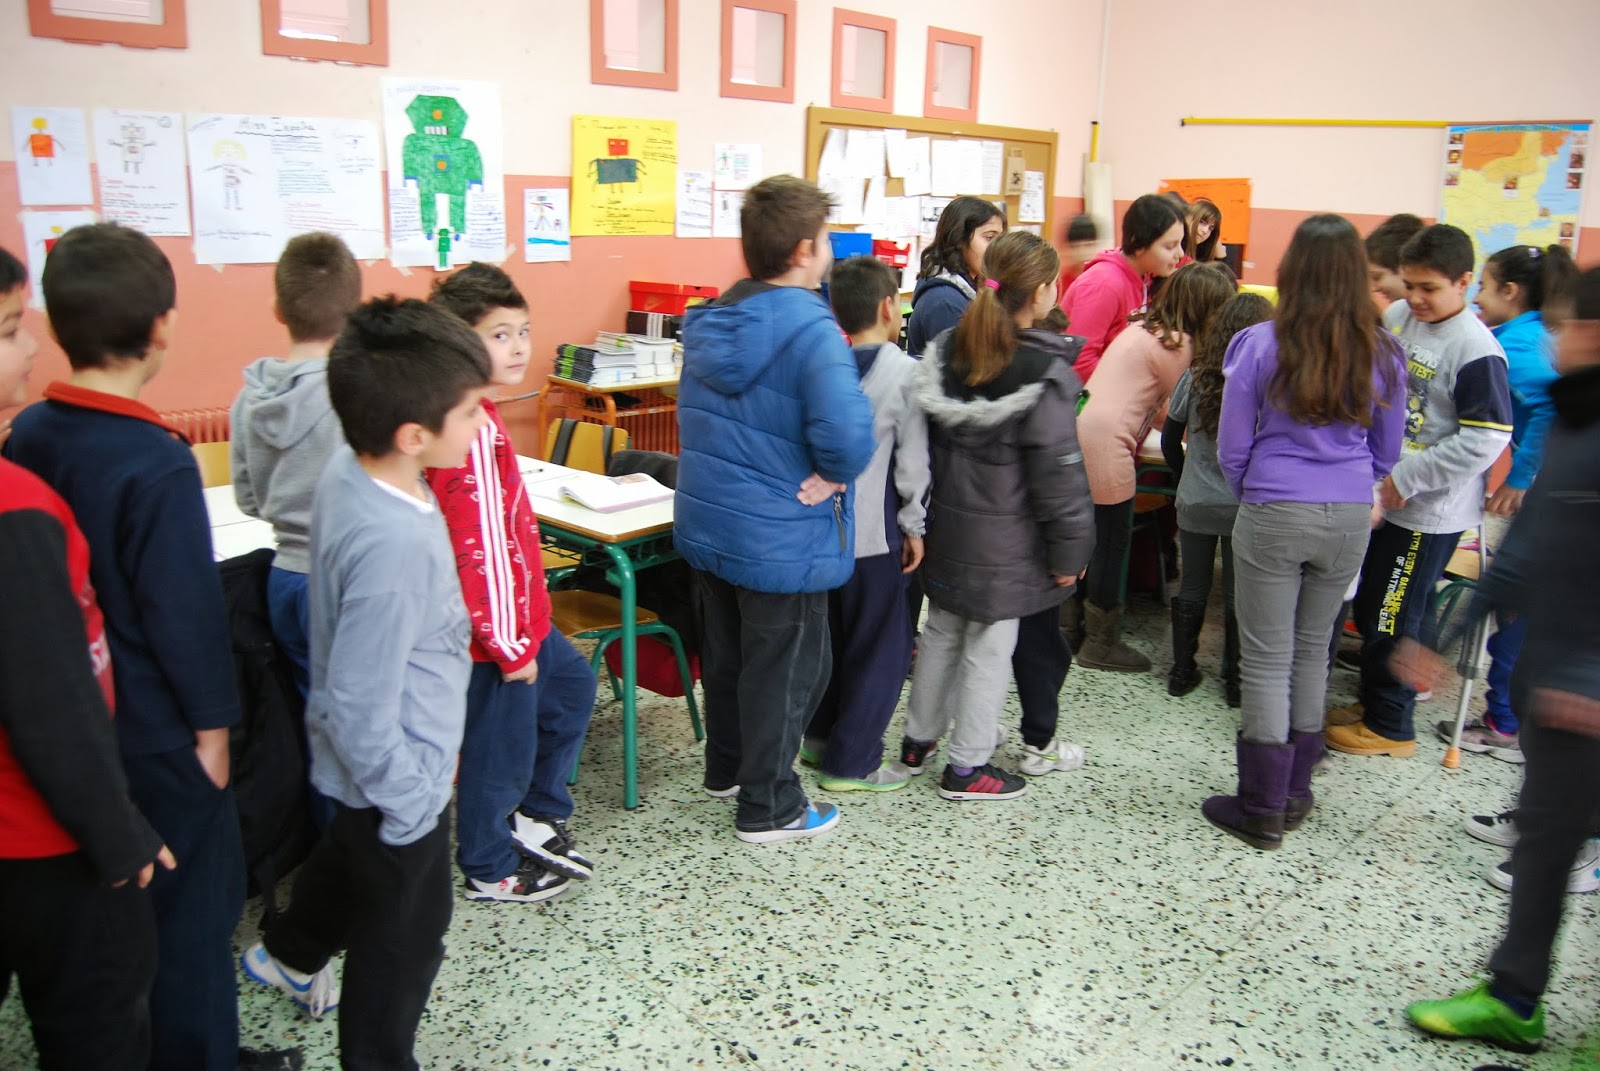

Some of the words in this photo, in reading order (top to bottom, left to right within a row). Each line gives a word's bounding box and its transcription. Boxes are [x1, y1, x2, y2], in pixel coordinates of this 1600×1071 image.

[1410, 530, 1422, 551] ATCH
[1395, 555, 1405, 567] OF
[1403, 551, 1417, 576] EVERY
